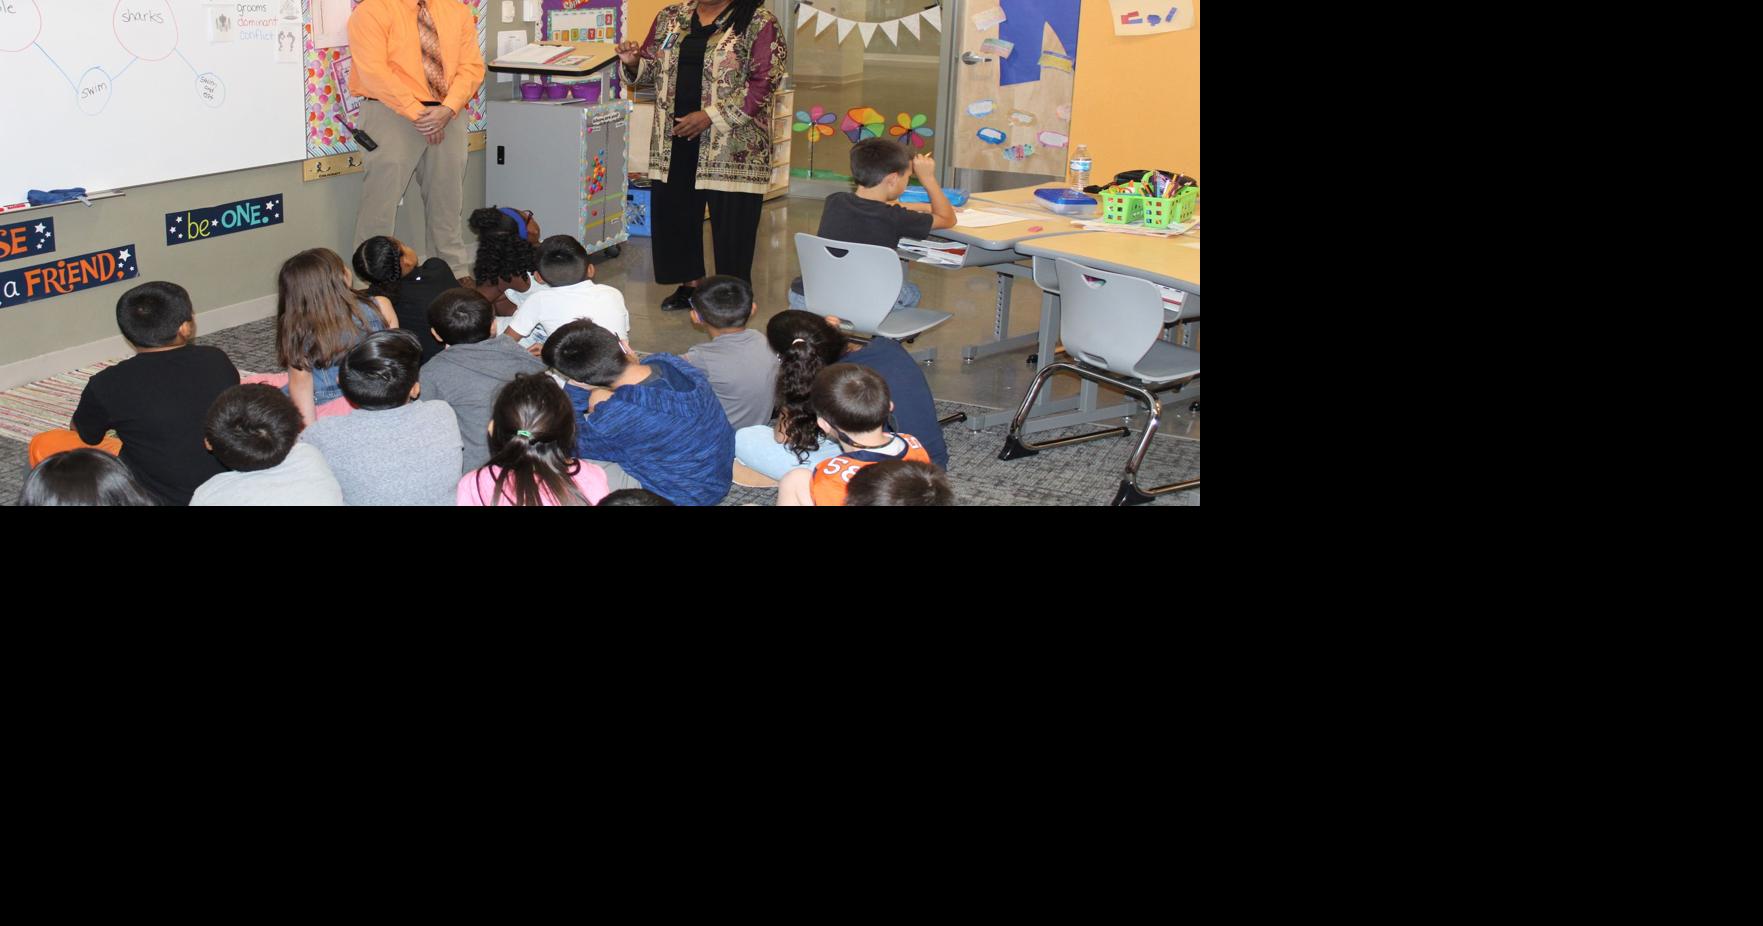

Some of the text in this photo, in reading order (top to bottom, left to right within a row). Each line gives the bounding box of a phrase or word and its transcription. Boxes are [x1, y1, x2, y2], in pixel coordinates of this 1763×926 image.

[121, 9, 164, 24] sharks
[236, 3, 267, 16] grooms
[237, 16, 279, 27] dominant
[81, 82, 107, 99] swim
[187, 203, 269, 240] be ONE.
[3, 281, 20, 298] a
